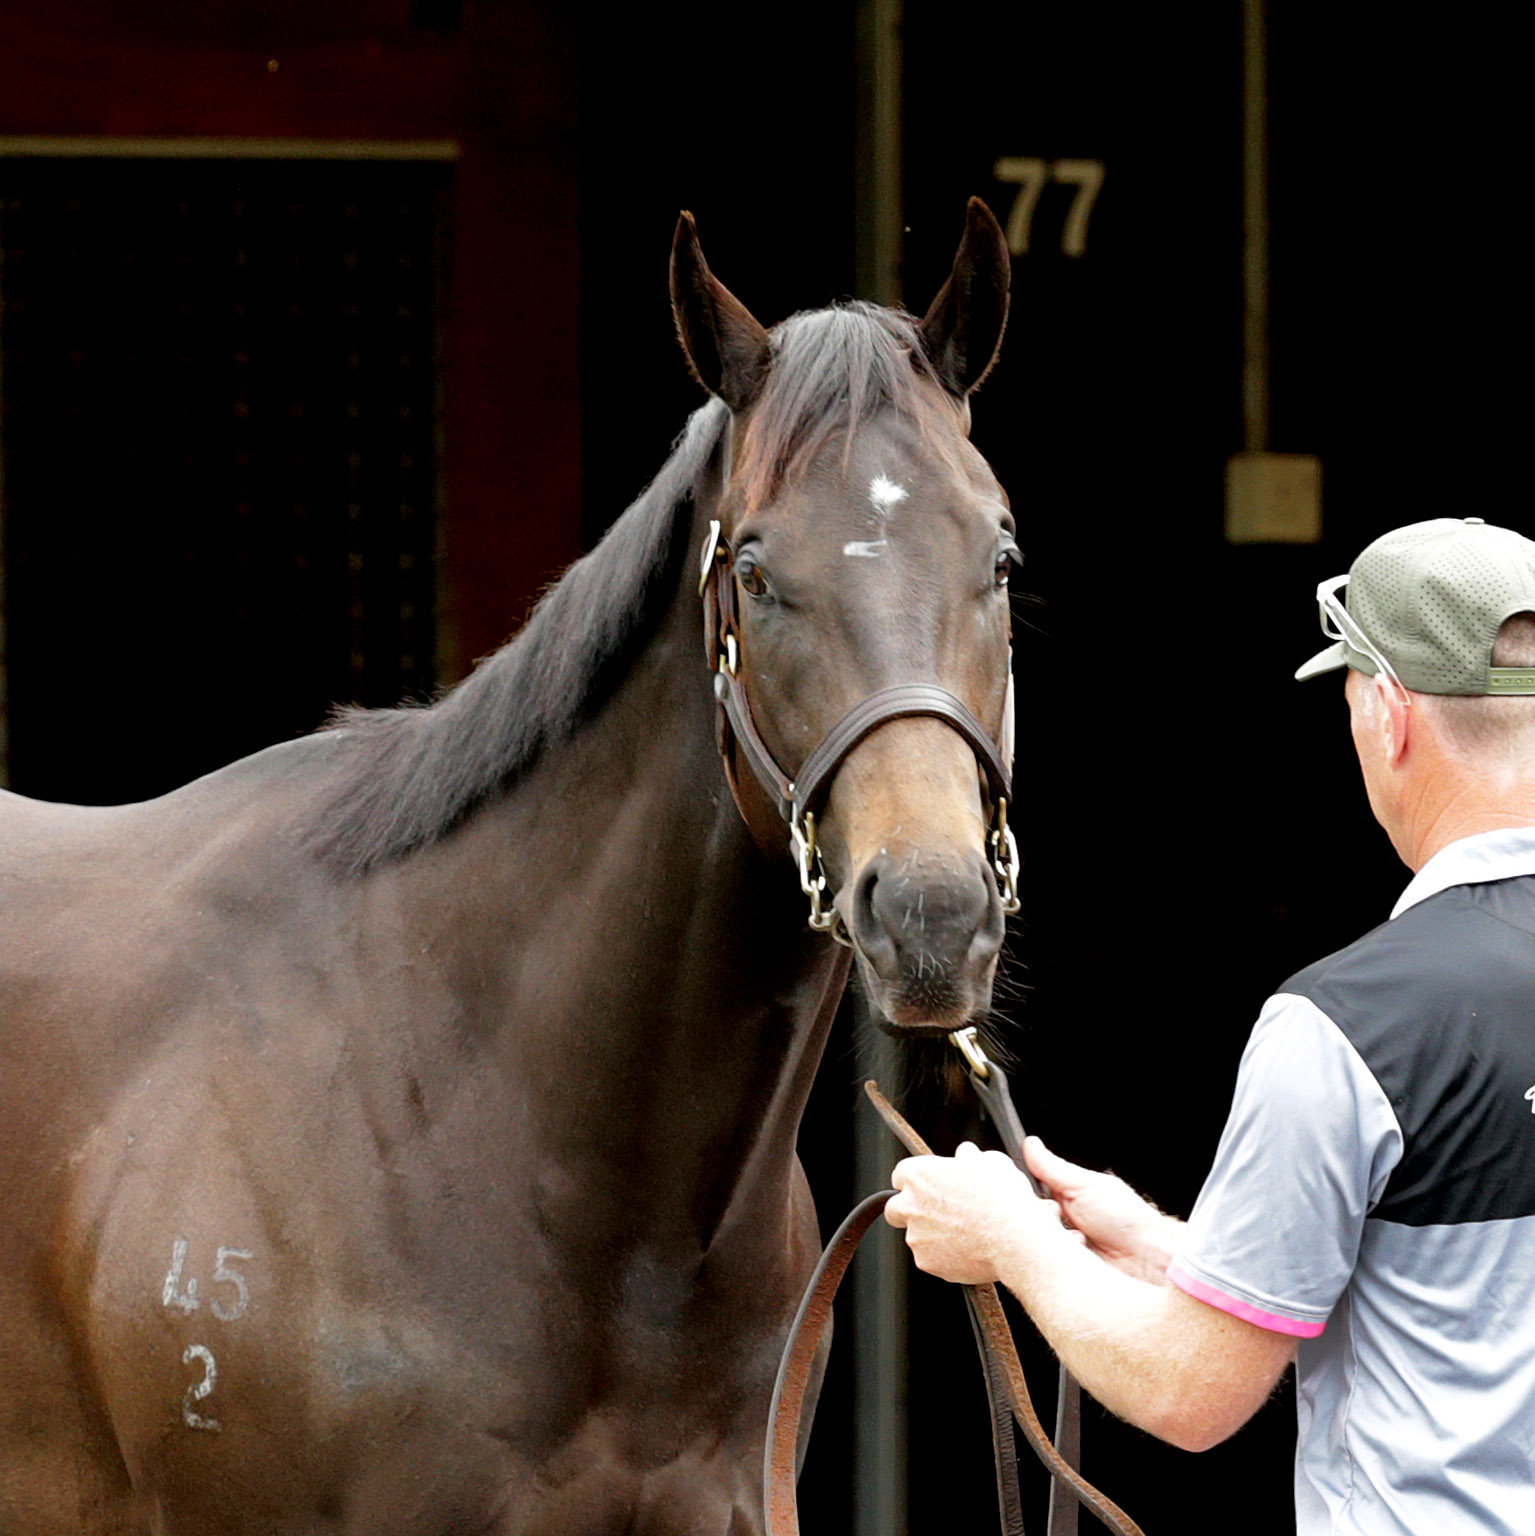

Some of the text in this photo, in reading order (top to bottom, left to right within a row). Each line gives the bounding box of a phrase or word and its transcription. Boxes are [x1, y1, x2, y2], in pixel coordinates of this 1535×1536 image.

[992, 156, 1106, 258] 77
[162, 1238, 255, 1321] 45
[181, 1344, 223, 1432] 2
